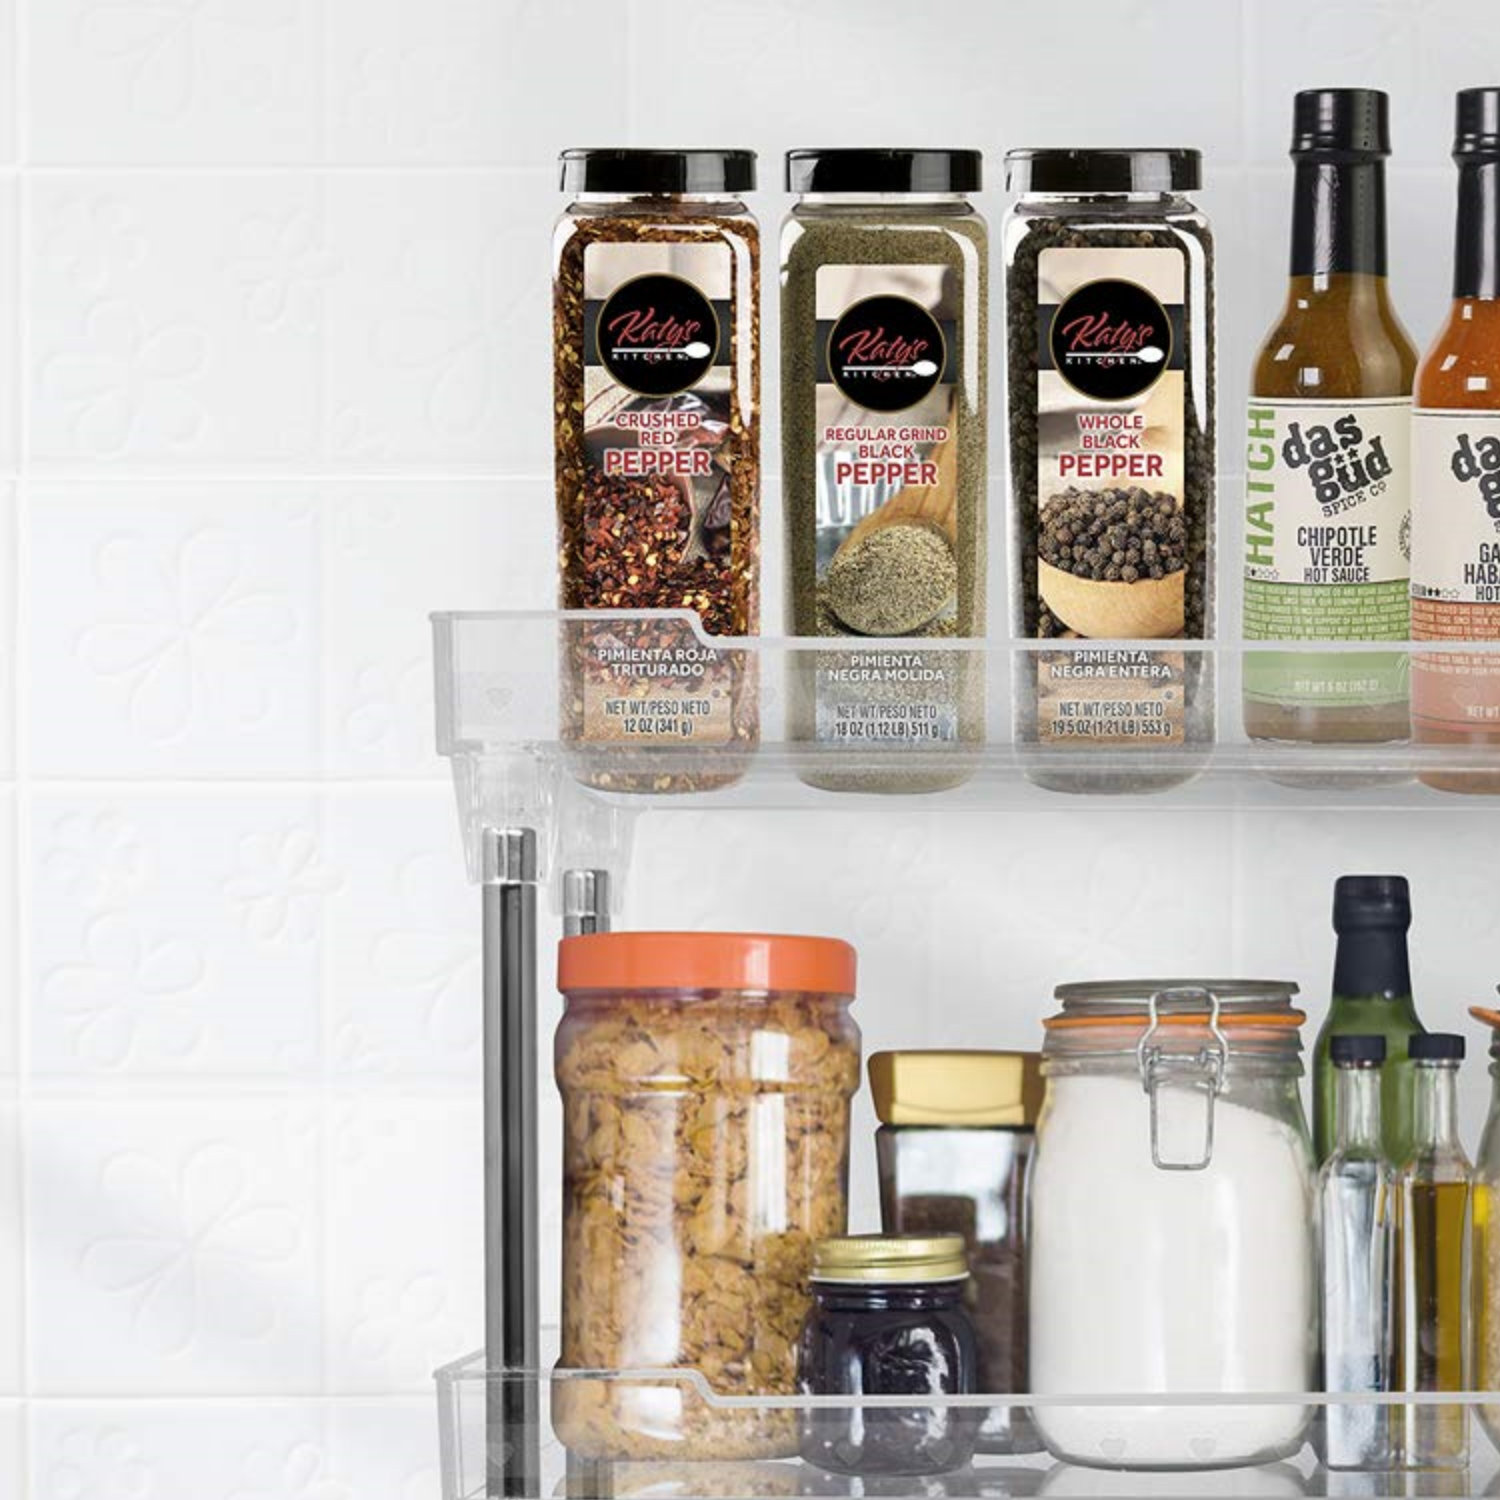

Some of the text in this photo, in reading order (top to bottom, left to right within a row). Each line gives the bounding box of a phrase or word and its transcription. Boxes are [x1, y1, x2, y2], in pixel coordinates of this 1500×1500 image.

[608, 307, 700, 352] Katy's
[1062, 311, 1154, 353] Katy's
[839, 327, 928, 370] Katy's
[611, 352, 686, 362] KITCHEN
[1065, 357, 1139, 366] KITCHEN
[615, 412, 700, 428] CRUSHED
[1078, 415, 1143, 430] WHOLE
[640, 430, 676, 446] RED
[825, 427, 948, 441] REGULAR GRIND
[1082, 435, 1141, 449] BLACK
[1282, 414, 1363, 469] das
[858, 445, 915, 459] BLACK
[605, 450, 711, 475] PEPPER
[1059, 454, 1164, 477] PEPPER
[836, 463, 938, 486] PEPPER
[1246, 409, 1276, 566] HATCH
[1322, 490, 1367, 518] SPICE
[1297, 525, 1377, 547] CHIPOTLE
[1310, 547, 1364, 567] VERDE
[1303, 567, 1371, 583] HOT SAUCE
[1475, 585, 1500, 601] HOT
[598, 649, 717, 661] PIMIENTA ROJA
[851, 655, 923, 667] PIMIENTA
[1074, 651, 1149, 663] PIMIENTA
[610, 663, 705, 677] TRITURADO
[828, 669, 945, 681] NEGRA MOLIDA
[1050, 665, 1172, 678] NEGRA ENTERA
[605, 700, 627, 715] NET
[681, 700, 711, 715] NETO
[837, 705, 856, 718] NET
[909, 705, 937, 718] NETO
[1059, 702, 1080, 716] NET
[1135, 702, 1163, 716] NETO
[624, 719, 693, 737] 12 OZ (341 g)
[849, 722, 863, 736] OZ
[891, 722, 909, 737] LB)
[911, 722, 929, 736] 511
[931, 725, 939, 738] g
[1076, 720, 1090, 734] OZ
[1121, 720, 1139, 735] LB)
[1141, 720, 1162, 734] 553
[1163, 723, 1171, 737] g
